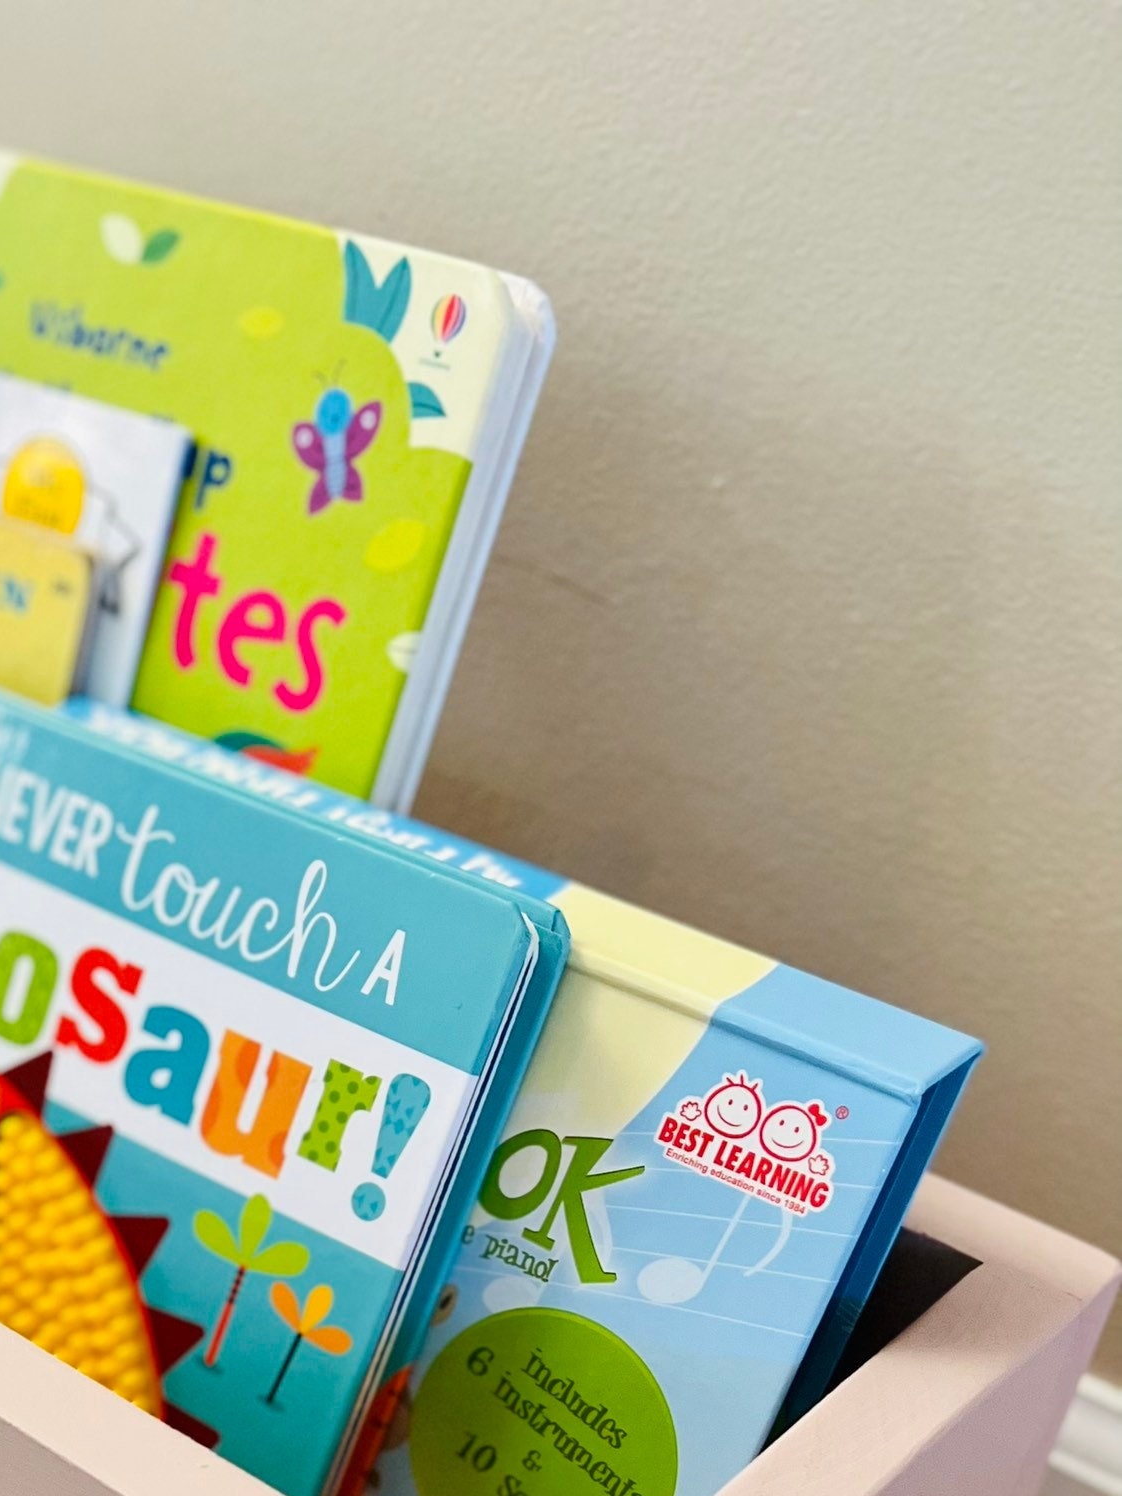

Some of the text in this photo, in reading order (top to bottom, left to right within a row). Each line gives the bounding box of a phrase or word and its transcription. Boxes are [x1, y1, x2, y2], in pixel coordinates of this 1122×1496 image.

[115, 806, 360, 993] touch
[360, 929, 407, 1006] A
[658, 1116, 830, 1208] BEST LEARNING
[665, 1147, 806, 1214] Enriching education since 1984
[479, 1235, 559, 1282] piano!
[467, 1346, 495, 1376] 6
[520, 1347, 628, 1450] includes
[456, 1430, 497, 1473] 10
[522, 1449, 542, 1472] &
